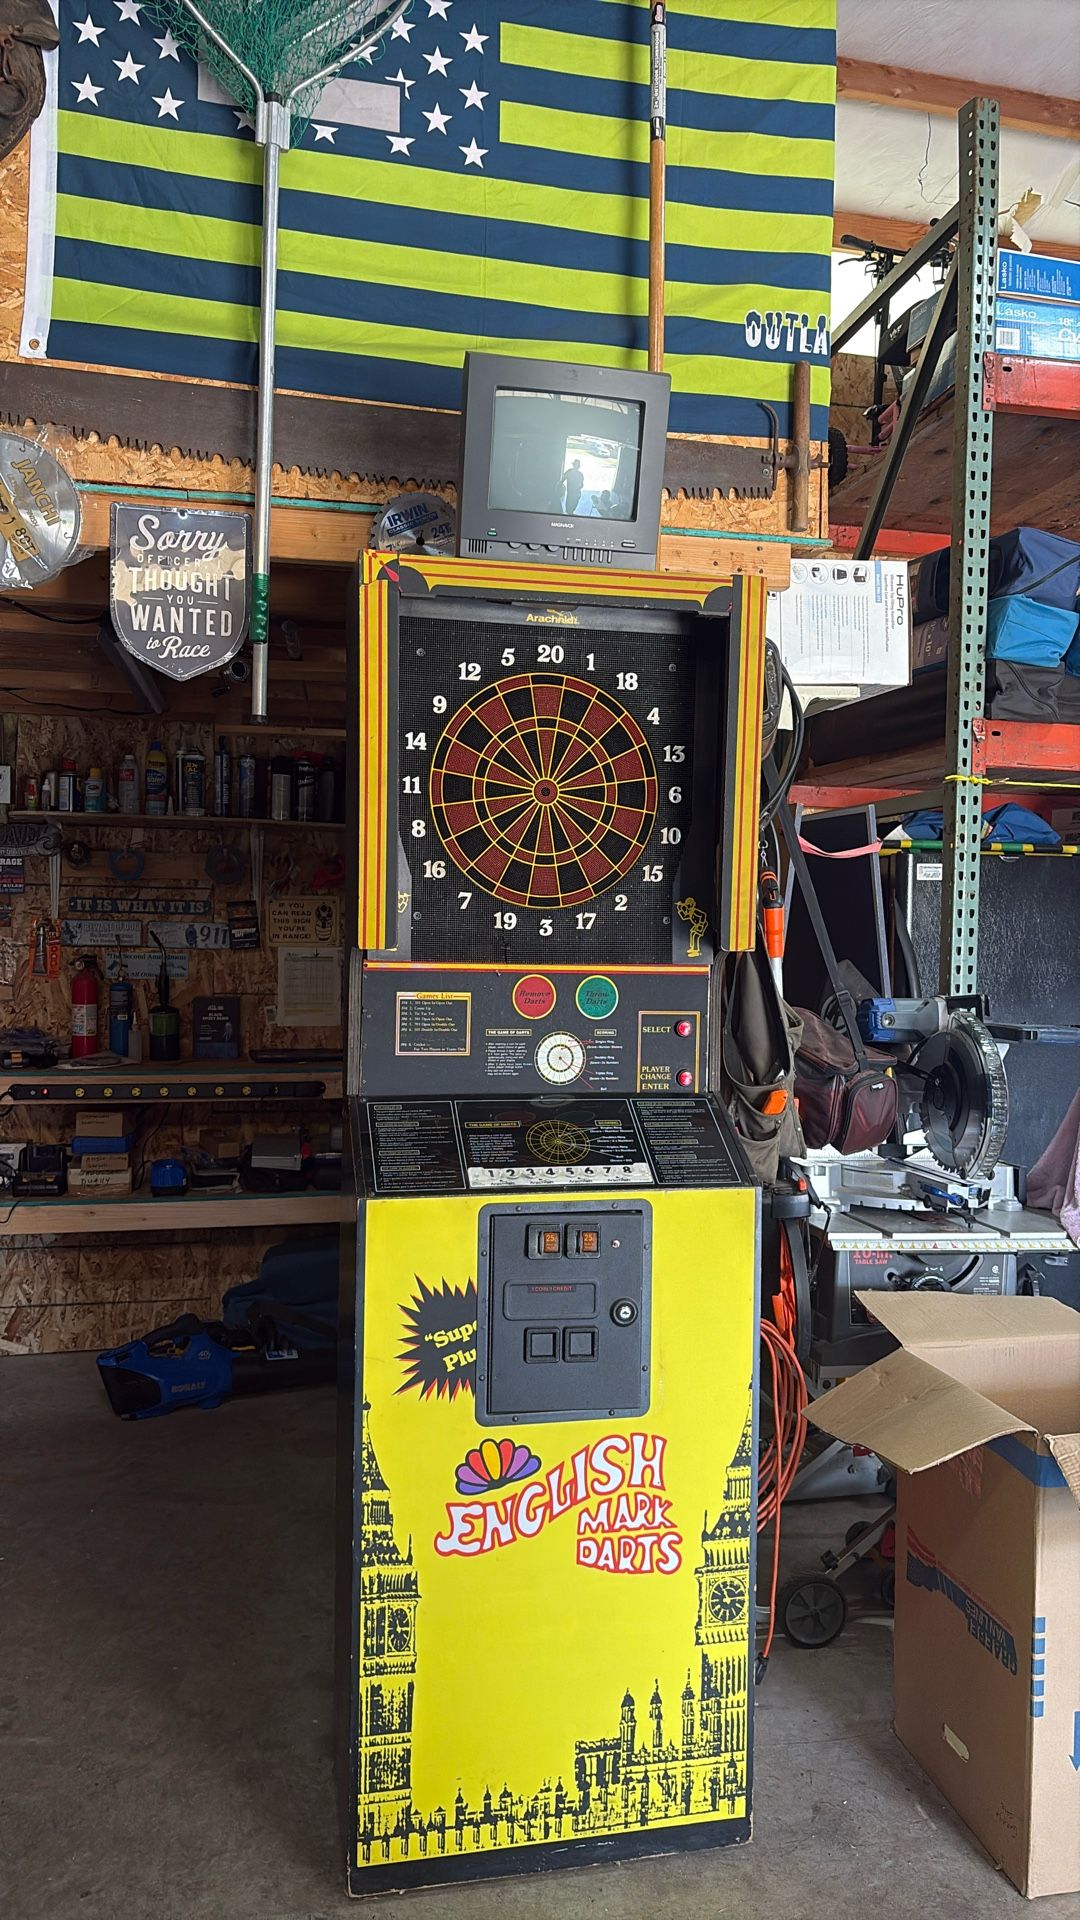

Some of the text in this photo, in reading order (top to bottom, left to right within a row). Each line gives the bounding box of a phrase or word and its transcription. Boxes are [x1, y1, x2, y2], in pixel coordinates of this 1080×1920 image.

[996, 301, 1037, 319] Lasko
[745, 309, 831, 356] OUTLA
[10, 458, 62, 527] JANCHI
[386, 502, 430, 528] IRWIN
[130, 513, 229, 562] Sorry
[129, 566, 238, 601] THOUGHT
[166, 594, 195, 605] YOU
[896, 574, 904, 626] HuPro
[131, 604, 234, 638] WANTED
[145, 635, 211, 660] to Race
[501, 648, 516, 666] 5
[537, 645, 565, 664] 20
[586, 653, 597, 671] 1
[458, 662, 482, 682] 12
[616, 672, 639, 691] 18
[432, 694, 448, 714] 9
[646, 707, 661, 726] 4
[405, 731, 427, 751] 14
[663, 744, 686, 763] 13
[402, 776, 422, 795] 11
[668, 785, 682, 805] 6
[410, 819, 426, 838] 8
[660, 826, 682, 846] 10
[422, 859, 447, 879] 16
[642, 864, 664, 883] 15
[77, 898, 205, 913] IT IS WHAT IT IS
[457, 891, 473, 911] 7
[614, 894, 628, 912] 2
[493, 912, 517, 931] 19
[539, 919, 553, 936] 3
[575, 912, 597, 931] 17
[199, 925, 229, 945] 911
[519, 990, 552, 998] Remove
[585, 990, 609, 998] Throw
[487, 1169, 496, 1178] 1
[506, 1168, 516, 1178] 2
[526, 1168, 536, 1177] 3
[545, 1168, 556, 1176] 4
[565, 1167, 575, 1176] 5
[584, 1167, 594, 1175] 6
[603, 1166, 612, 1174] 7
[622, 1166, 633, 1174] 8
[443, 1350, 478, 1373] Plu
[434, 1433, 667, 1557] ENGLISH
[577, 1494, 677, 1535] MARK
[576, 1534, 683, 1575] DARTS
